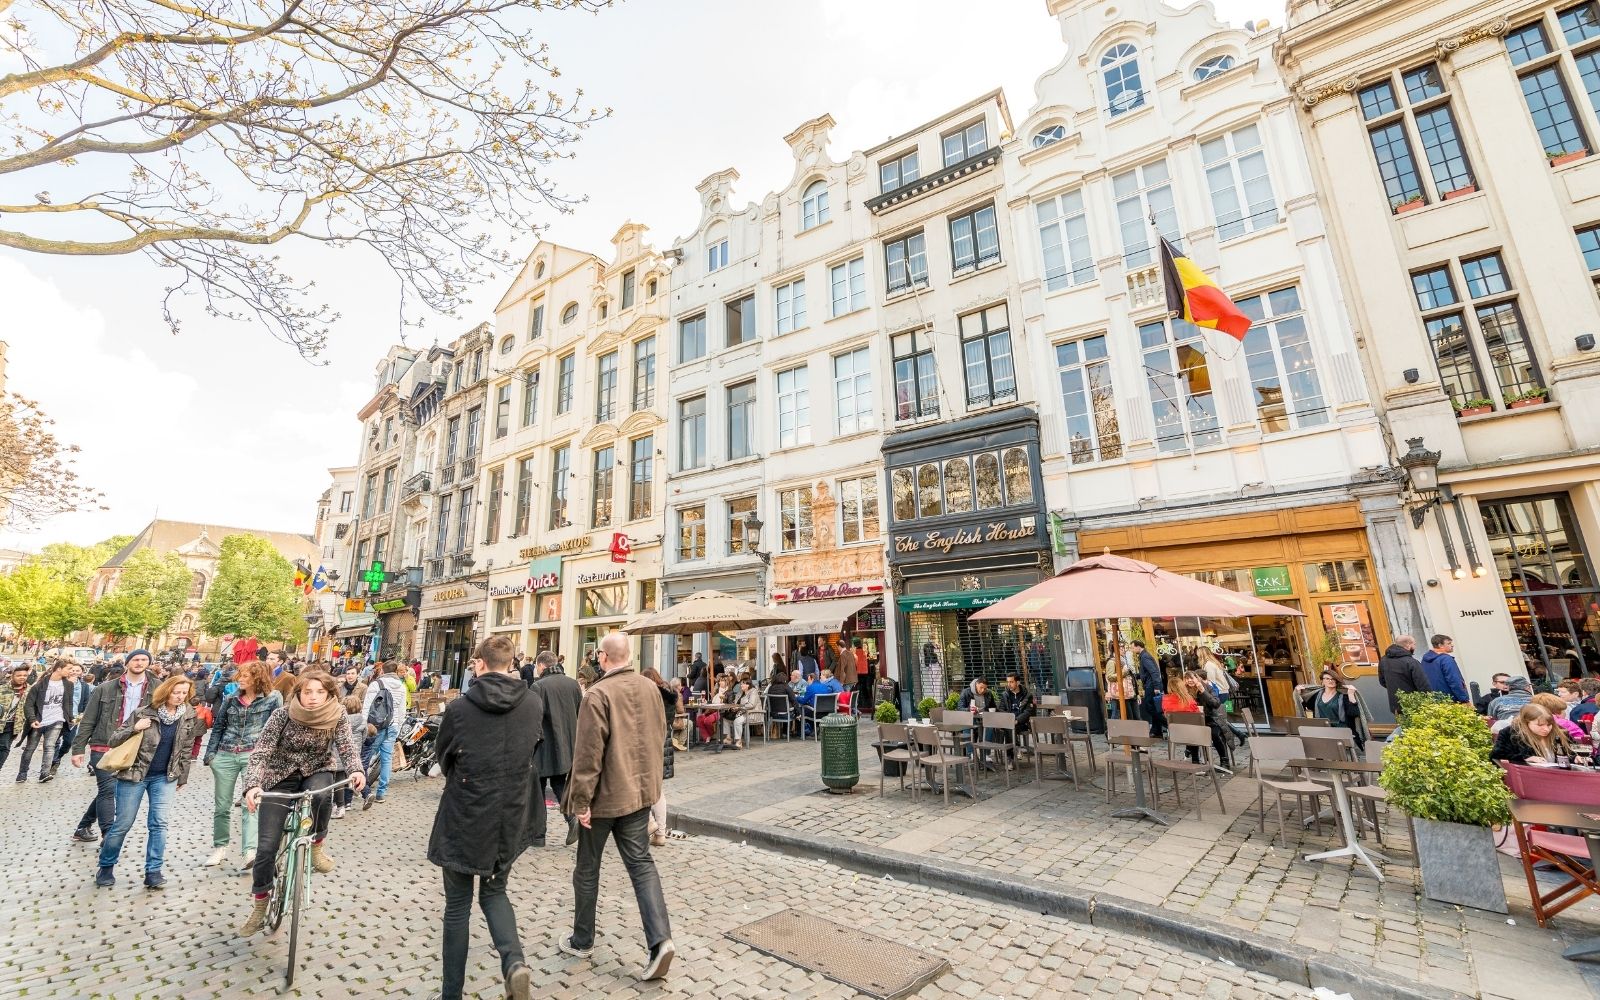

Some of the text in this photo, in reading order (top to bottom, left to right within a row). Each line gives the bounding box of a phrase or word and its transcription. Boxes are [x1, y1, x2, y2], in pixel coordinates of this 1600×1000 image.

[895, 535, 919, 552] The
[924, 528, 982, 554] English
[985, 522, 1035, 541] House
[519, 545, 548, 559] STELLA
[577, 568, 626, 584] Restaurant
[490, 573, 559, 596] Hamburger Quick
[791, 587, 806, 600] The
[806, 584, 836, 600] Purple
[837, 582, 863, 596] Rose
[433, 587, 467, 601] AGORA
[923, 602, 941, 610] English
[1460, 609, 1494, 618] Jupiler
